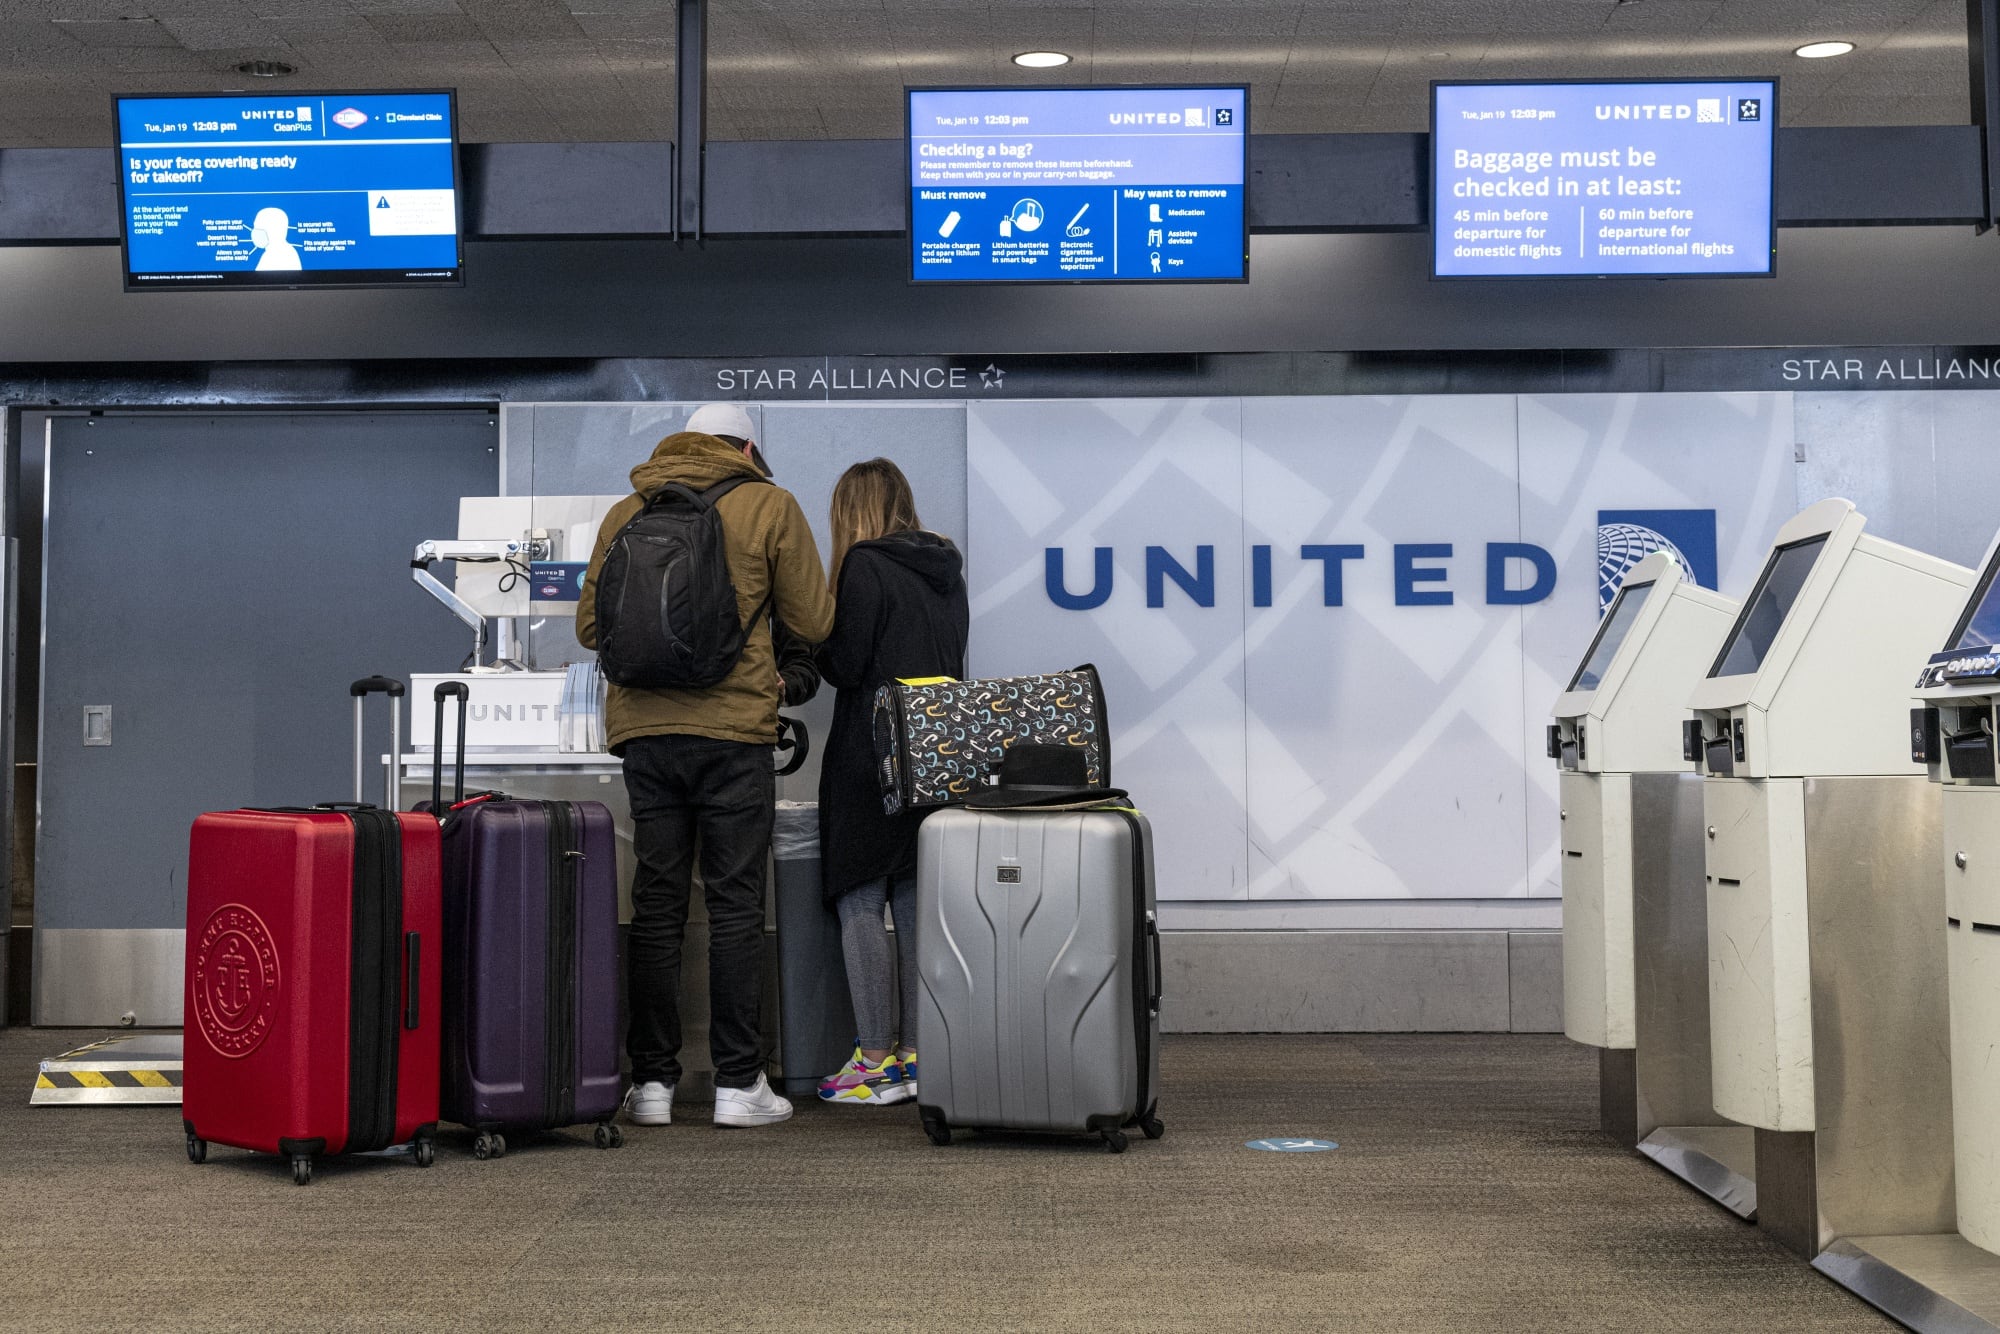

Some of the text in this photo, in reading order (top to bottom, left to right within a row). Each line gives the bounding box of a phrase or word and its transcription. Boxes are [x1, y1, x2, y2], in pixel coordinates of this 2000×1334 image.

[242, 110, 295, 120] UNITED
[1110, 112, 1181, 124] UNITED
[1462, 110, 1556, 120] Tue, Jan 19 12:03 pm
[1595, 105, 1691, 120] UNITED
[936, 116, 1028, 126] Tue, Jan 19 12:03 pm
[144, 124, 162, 132] Tue,
[162, 124, 175, 133] Jan
[192, 122, 218, 131] 12:03
[220, 122, 237, 133] pm
[274, 123, 312, 132] CleanPlus
[920, 143, 1033, 159] Checking a bag?
[130, 155, 296, 171] Is your face covering ready
[920, 161, 946, 169] Please
[948, 160, 991, 169] remember
[992, 160, 1001, 168] to
[1035, 160, 1057, 168] these
[1059, 160, 1082, 168] items
[1084, 159, 1133, 168] beforehand.
[1454, 146, 1656, 173] Baggage must be
[131, 171, 203, 183] for takeoff?
[920, 171, 941, 181] Keep
[942, 170, 964, 179] them
[966, 170, 984, 179] with
[985, 171, 1001, 180] you
[1013, 170, 1021, 178] in
[1023, 171, 1042, 180] your
[1043, 171, 1077, 180] carry-on
[1079, 169, 1115, 180] baggage.
[1454, 175, 1681, 197] checked in at least:
[921, 190, 946, 200] Must
[1124, 189, 1227, 200] May want to remove
[1454, 209, 1548, 221] 45 min before
[1599, 207, 1694, 220] 60 min before
[134, 227, 164, 235] covering:
[1454, 227, 1546, 242] departure for
[1599, 225, 1691, 240] departure for
[952, 242, 980, 250] chargers
[1019, 241, 1049, 249] batteries
[1599, 242, 1734, 257] international flights
[936, 250, 954, 258] spare
[1454, 244, 1562, 259] domestic flights
[1021, 256, 1037, 264] bags
[1074, 256, 1103, 264] personal
[1168, 258, 1183, 266] Keys
[1782, 359, 1863, 380] STAR
[716, 368, 967, 390] STAR ALLIANCE
[1044, 542, 1558, 611] UNITED
